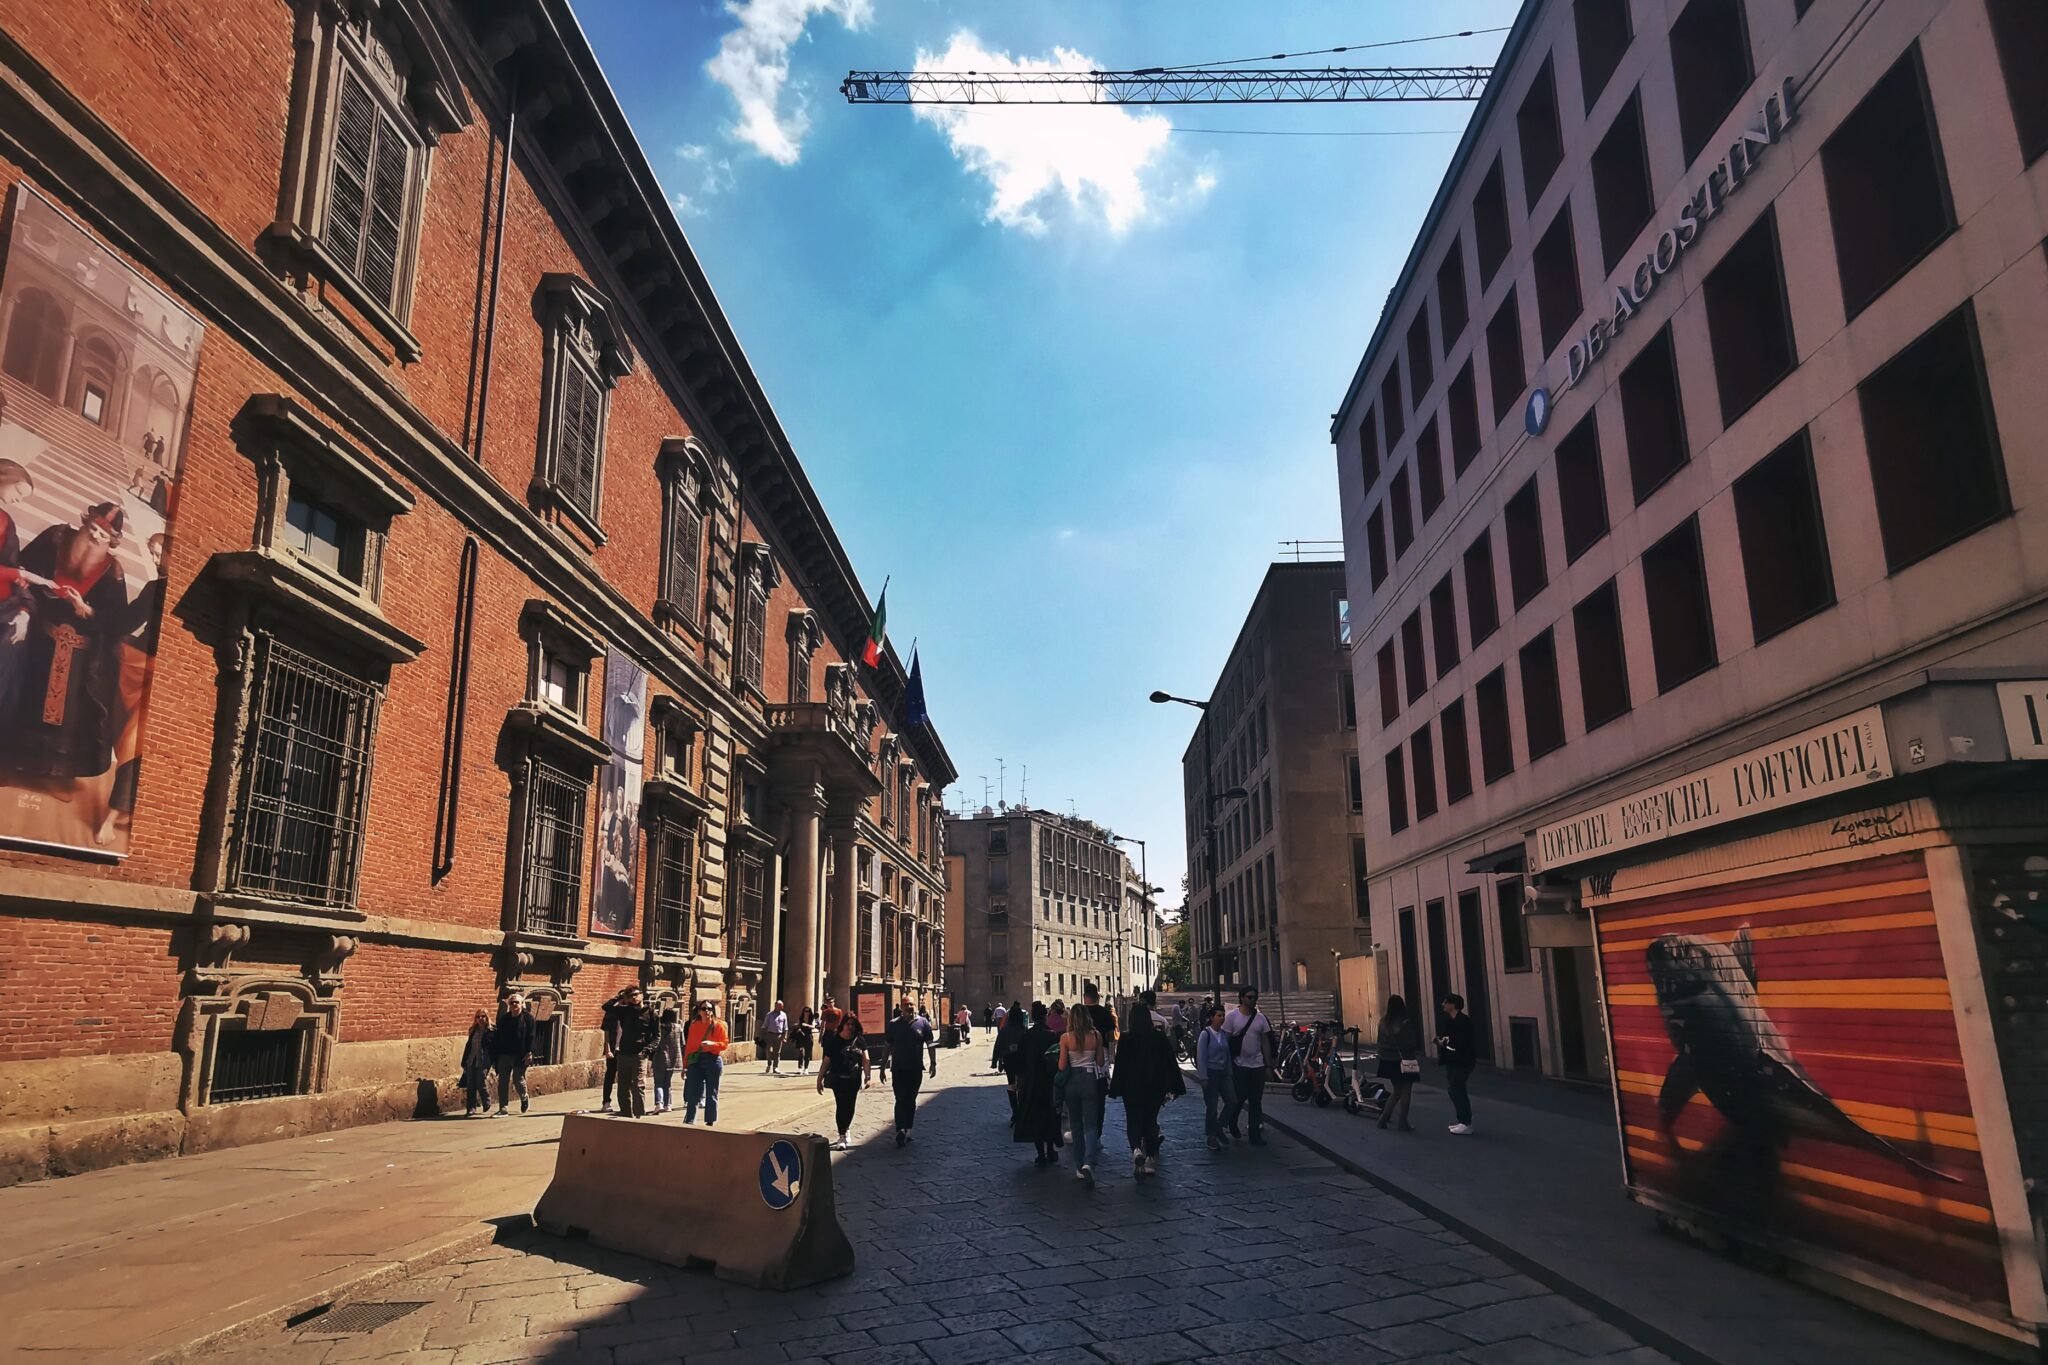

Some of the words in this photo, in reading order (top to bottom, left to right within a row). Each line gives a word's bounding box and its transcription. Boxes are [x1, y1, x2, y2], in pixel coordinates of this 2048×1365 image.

[1567, 318, 1607, 391] DE
[1609, 76, 1797, 338] AGOSTINI
[1542, 813, 1612, 862] L'OFFICIEL
[1733, 725, 1878, 807] L'OFFICIEL
[1863, 722, 1873, 749] ITALIA
